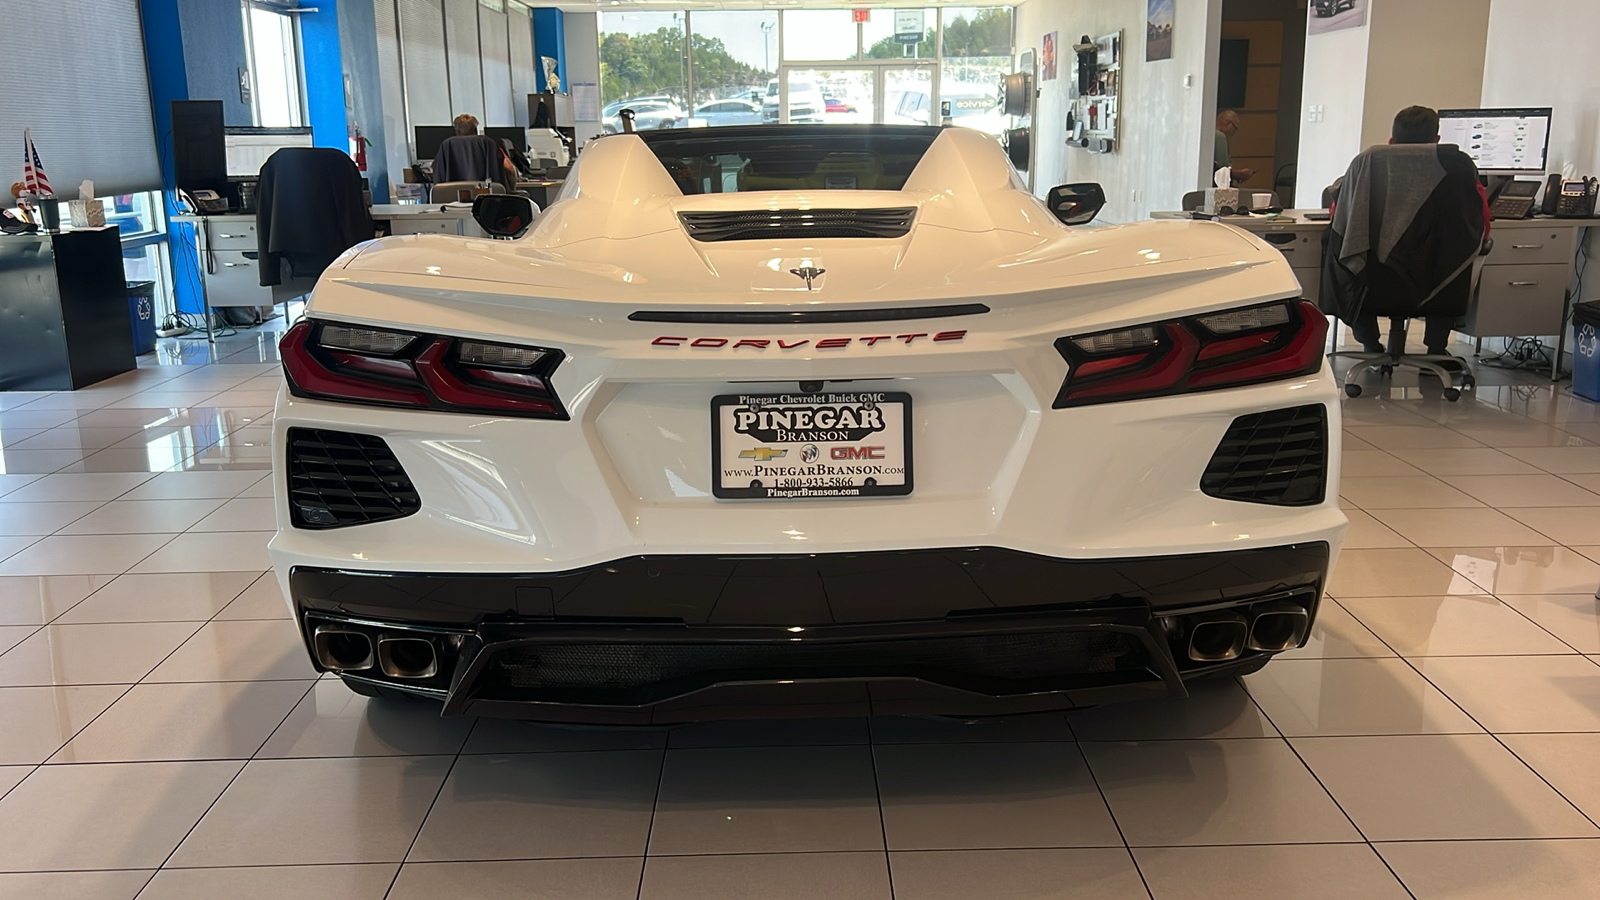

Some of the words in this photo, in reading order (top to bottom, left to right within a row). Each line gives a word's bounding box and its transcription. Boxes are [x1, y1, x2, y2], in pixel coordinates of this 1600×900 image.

[651, 330, 968, 349] CORVETTE
[739, 396, 777, 406] Pinegar
[780, 395, 826, 404] Chevrolet
[829, 394, 857, 403] Buick
[859, 393, 885, 403] GMC
[737, 408, 882, 431] PINEGAR
[830, 446, 886, 460] GMC
[774, 477, 854, 488] 1-800-933-5866
[767, 488, 860, 498] PinegarBranson.com
